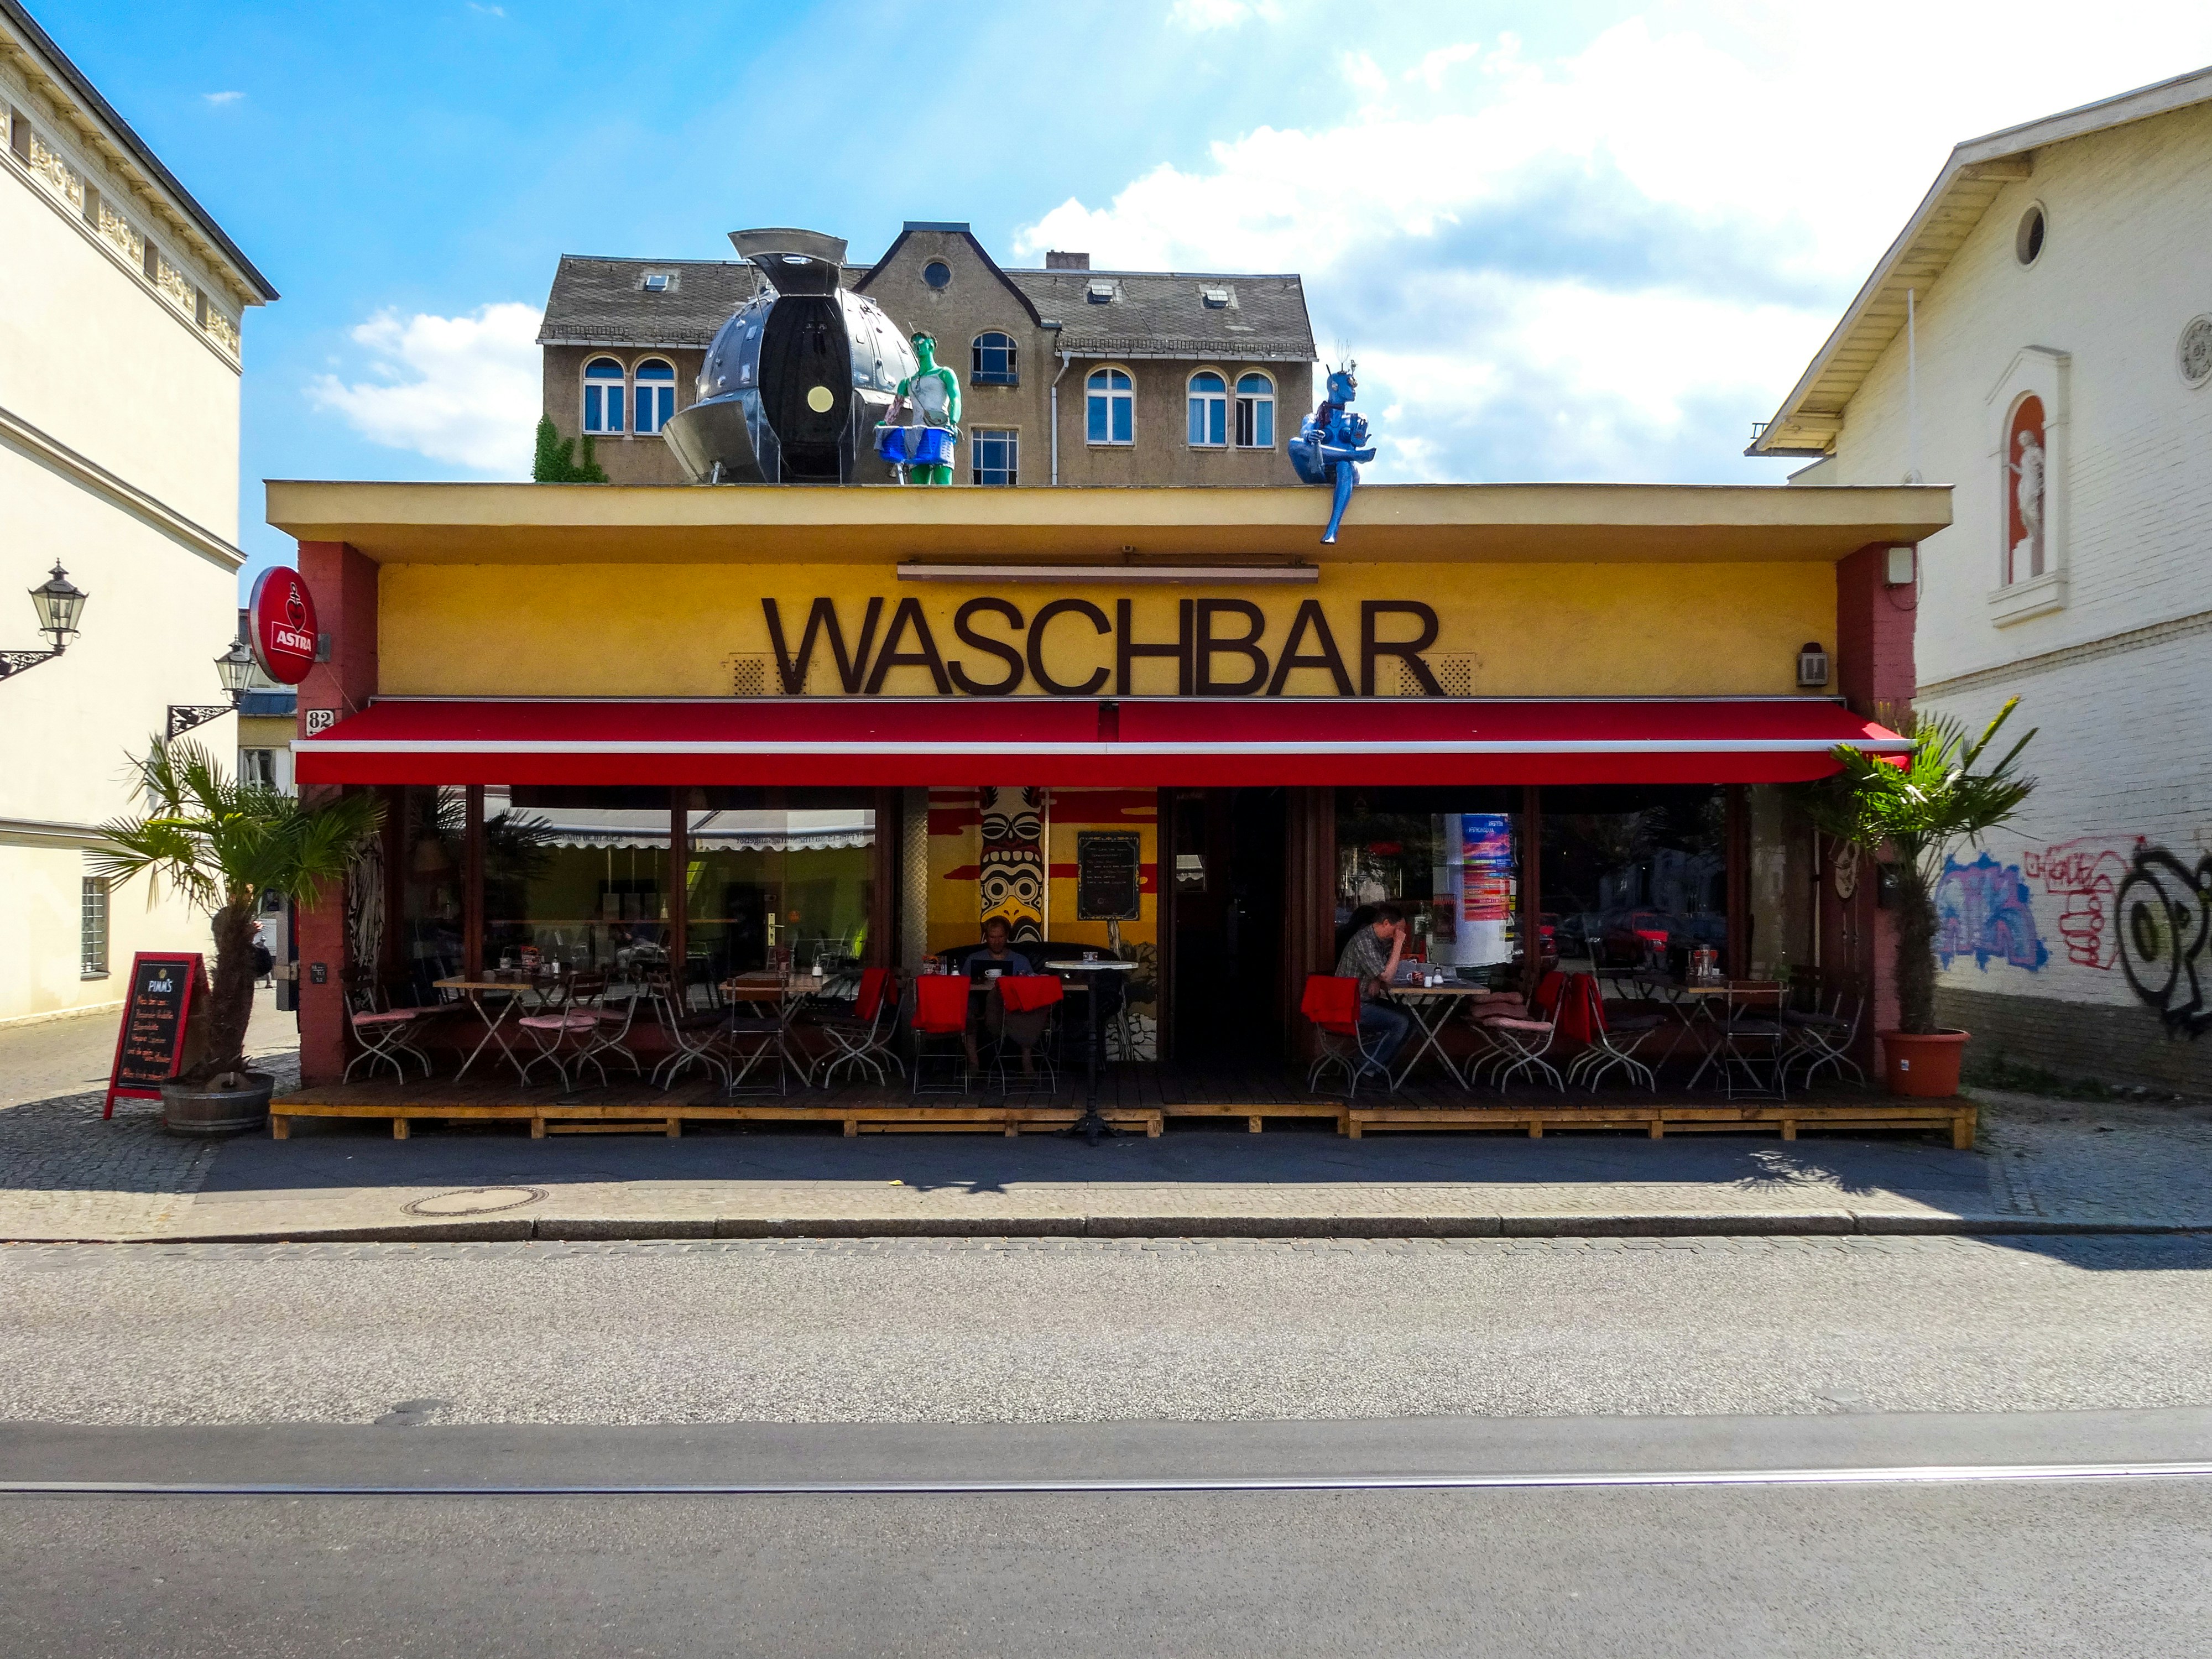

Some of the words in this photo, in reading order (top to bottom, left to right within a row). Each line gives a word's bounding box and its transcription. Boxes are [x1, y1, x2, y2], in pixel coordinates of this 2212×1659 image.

[276, 630, 311, 651] ASTRA
[761, 597, 1446, 696] WASCHBAR
[309, 712, 331, 728] 82
